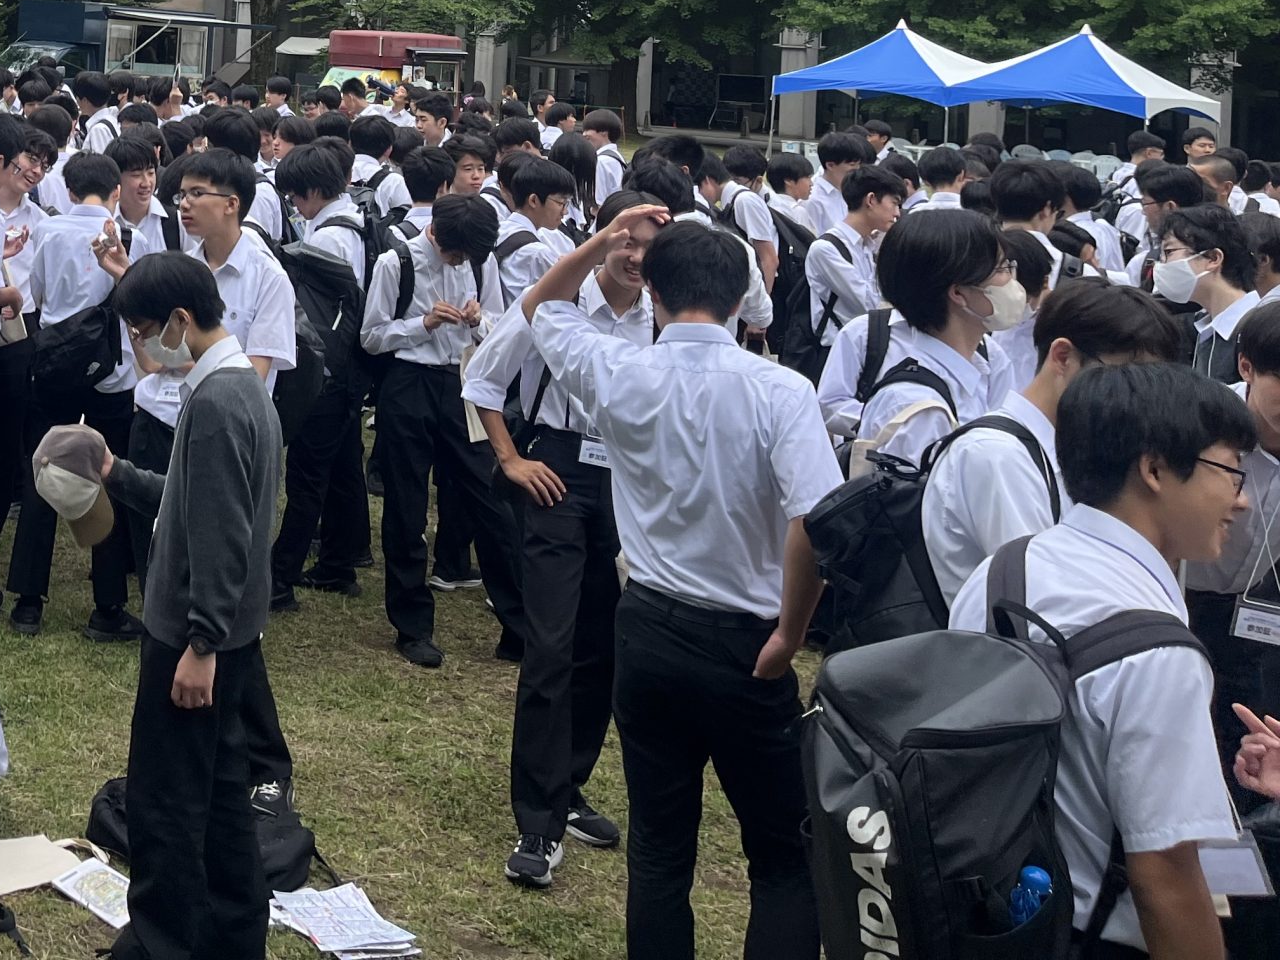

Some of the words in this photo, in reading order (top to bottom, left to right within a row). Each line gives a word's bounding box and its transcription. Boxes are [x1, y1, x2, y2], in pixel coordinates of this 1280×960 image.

[1247, 624, 1272, 636] 参加証
[846, 805, 900, 960] IDAS
